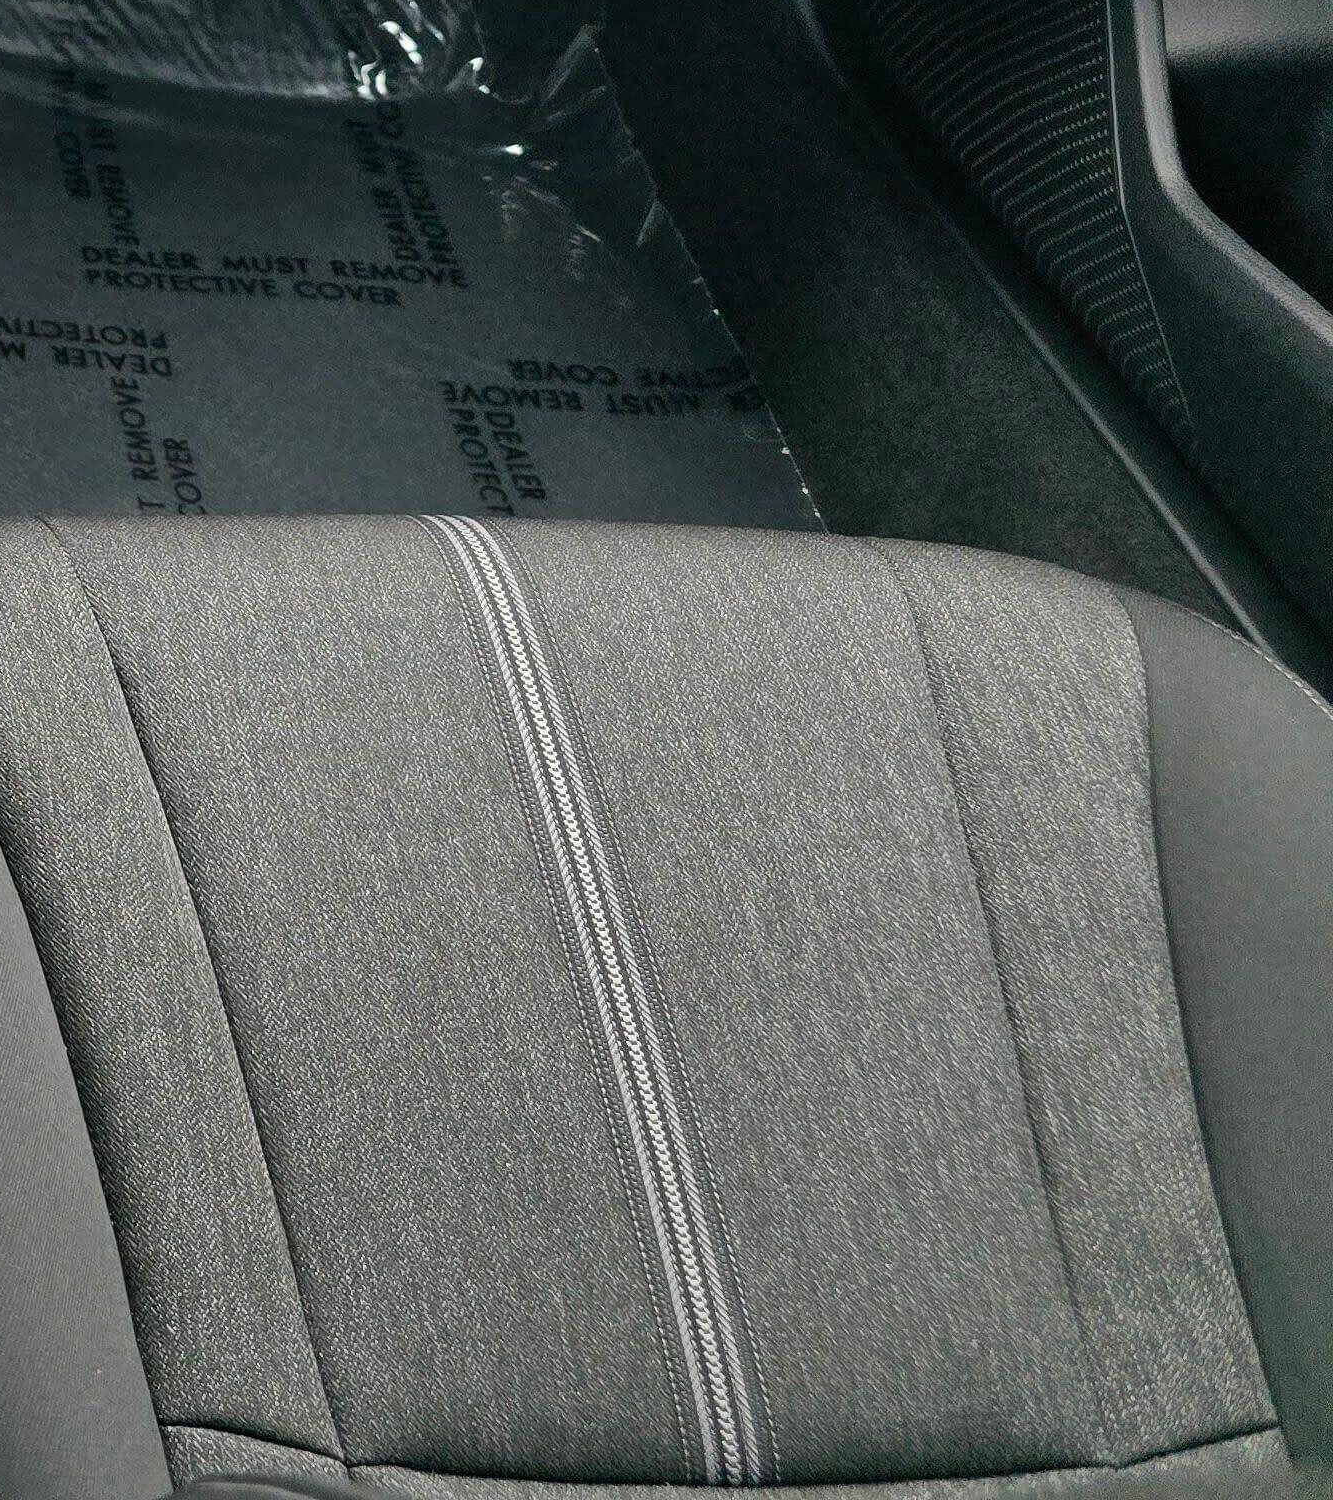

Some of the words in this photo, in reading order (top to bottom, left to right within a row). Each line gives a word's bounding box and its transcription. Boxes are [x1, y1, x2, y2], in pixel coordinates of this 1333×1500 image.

[80, 246, 202, 271] DEALER
[222, 254, 311, 275] MUST
[329, 258, 471, 290] REMOVE
[84, 269, 281, 298] PROTECTIVE
[293, 279, 403, 307] COVER
[50, 344, 173, 379] DEALER
[506, 358, 619, 387] COVER
[438, 380, 584, 412] REMOVE
[111, 375, 161, 482] REMOVE
[483, 411, 548, 501] DEALER
